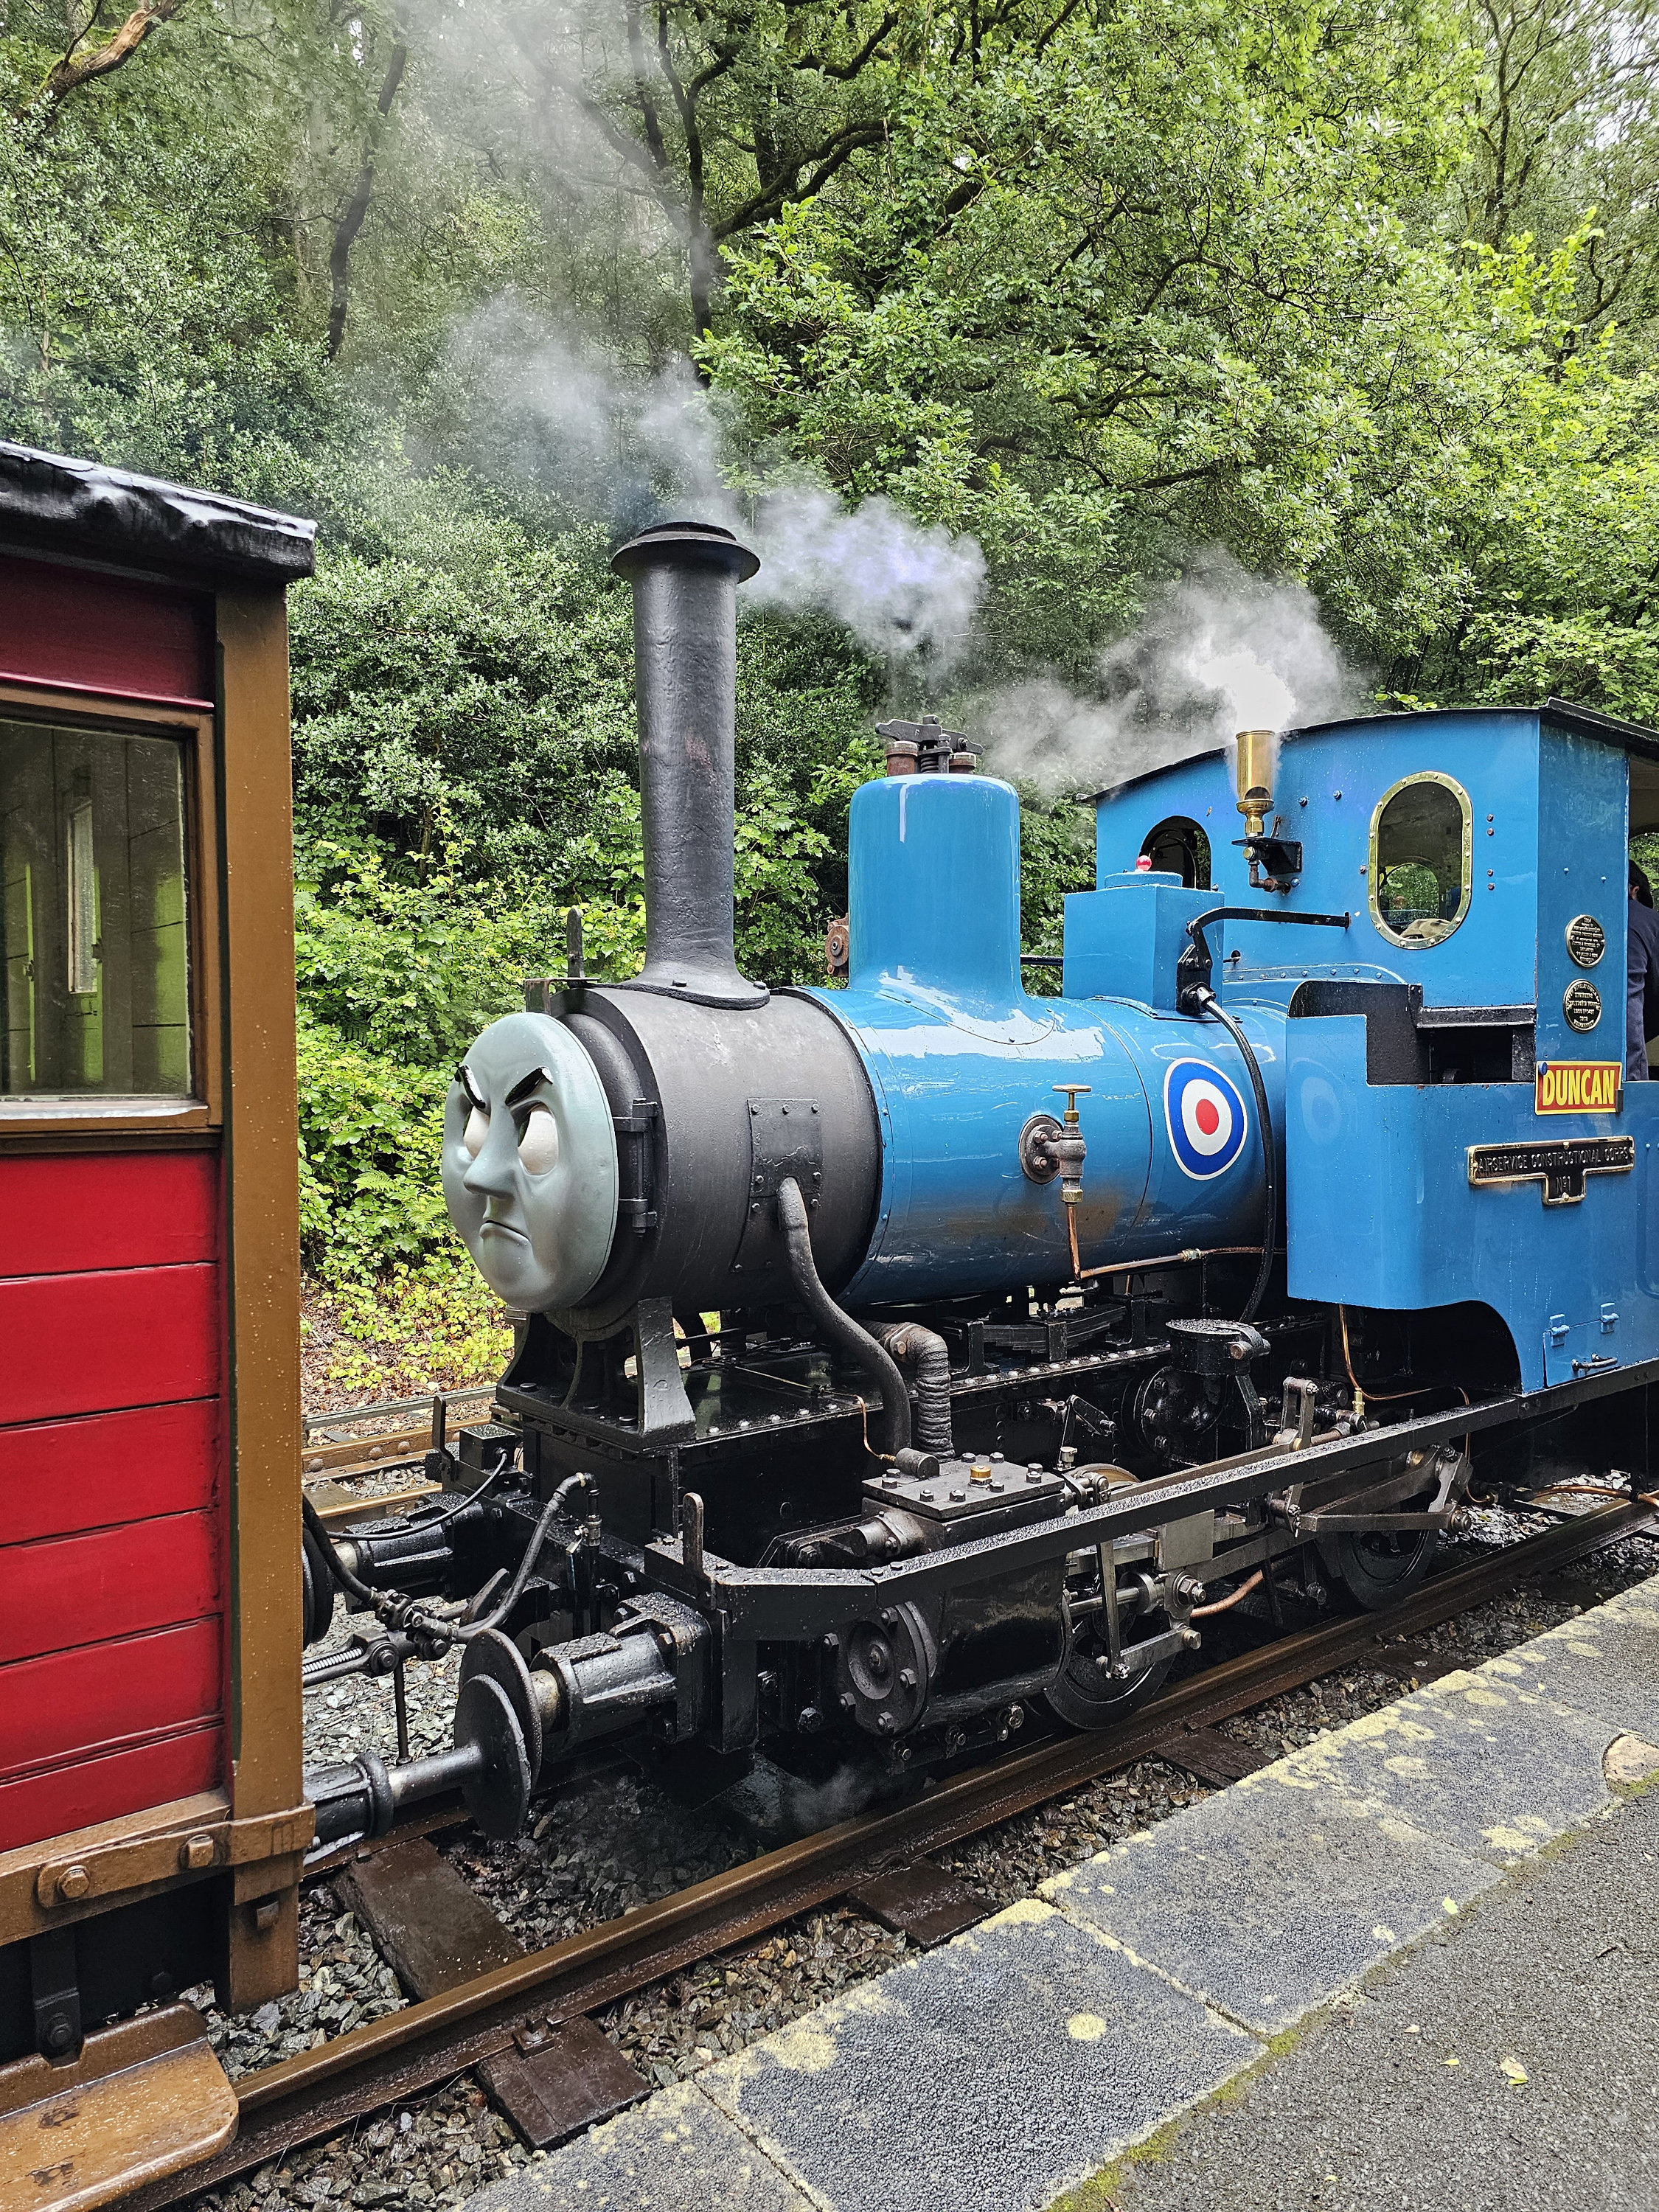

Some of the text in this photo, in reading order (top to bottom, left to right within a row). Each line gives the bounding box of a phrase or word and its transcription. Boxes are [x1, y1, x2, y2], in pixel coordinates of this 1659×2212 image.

[1543, 1069, 1615, 1106] DUNCAN
[1477, 1146, 1630, 1174] AIRSERVICE CONSTRUCTIONAL CORPS
